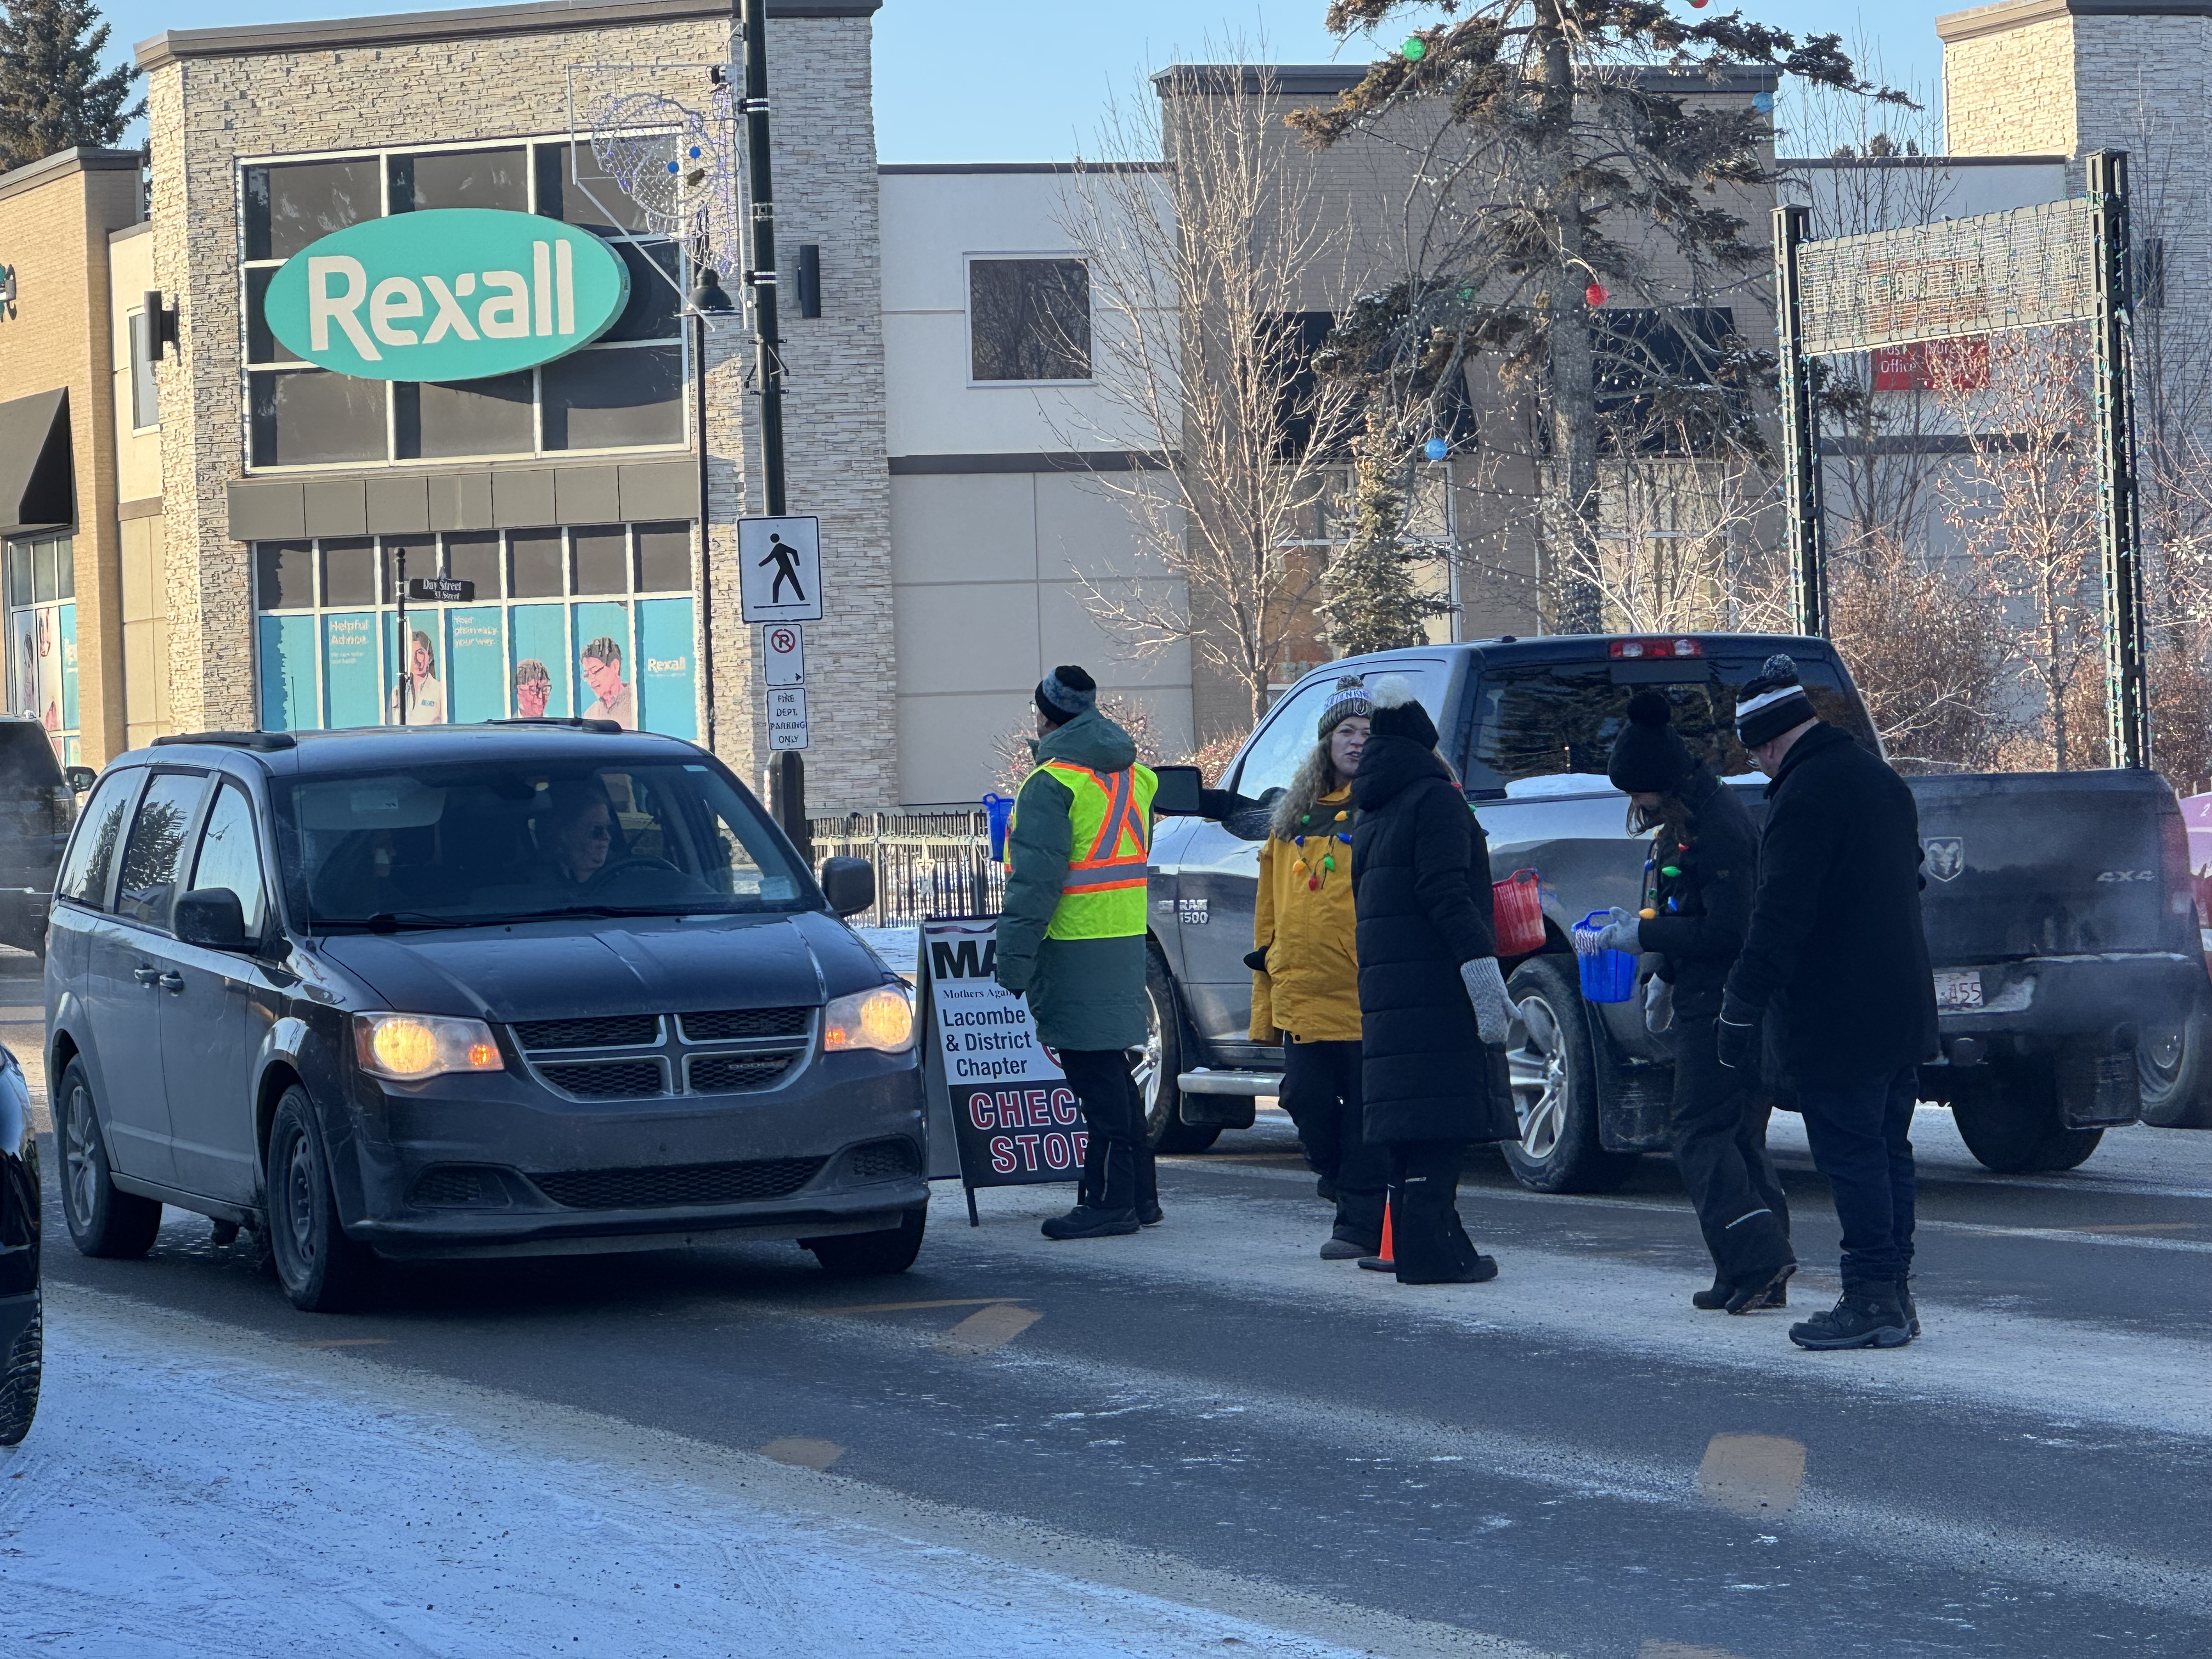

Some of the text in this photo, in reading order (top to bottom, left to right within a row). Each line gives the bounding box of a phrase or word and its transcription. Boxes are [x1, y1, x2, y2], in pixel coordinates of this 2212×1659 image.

[308, 239, 574, 361] Rexall
[1880, 344, 1907, 356] Pos
[1881, 358, 1917, 374] Office
[423, 578, 461, 591] Day Street
[330, 619, 369, 633] Helpful
[777, 693, 794, 703] FIRE
[770, 721, 805, 730] PARKING
[778, 735, 799, 743] ONLY
[1179, 899, 1208, 911] RAM
[1179, 912, 1209, 924] 1500
[931, 940, 997, 980] MA
[944, 989, 1011, 999] Mothers Agai
[943, 1006, 1025, 1026] Lacombe
[946, 1031, 1032, 1052] & District
[956, 1057, 1028, 1079] Chapter
[969, 1087, 1088, 1130] CHEC
